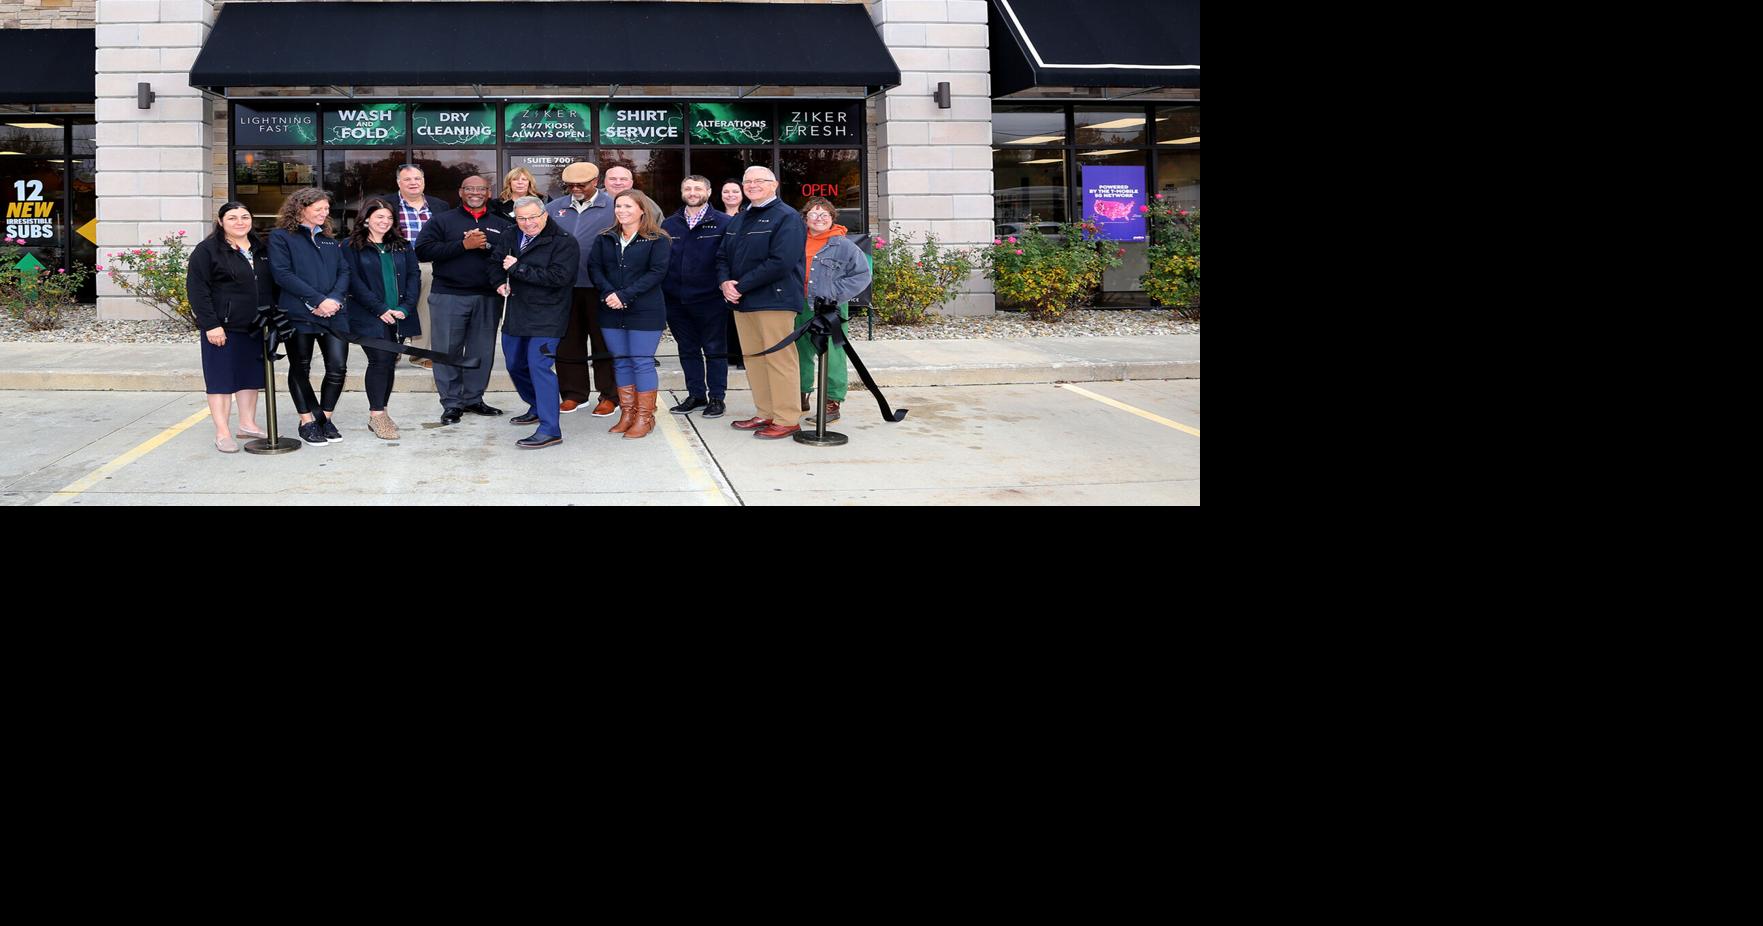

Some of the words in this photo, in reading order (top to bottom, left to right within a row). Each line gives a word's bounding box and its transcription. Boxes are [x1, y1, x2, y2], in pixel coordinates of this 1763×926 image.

[240, 116, 312, 125] LIGHTNING
[338, 110, 392, 121] WASH
[440, 112, 469, 122] DRY
[616, 110, 667, 121] SHIRT
[791, 111, 847, 123] ZIKER
[259, 124, 289, 132] FAST
[696, 120, 766, 128] ALTERATIONS
[341, 128, 388, 139] FOLD
[417, 126, 492, 136] CLEANING
[606, 126, 678, 138] SERVICE
[785, 125, 854, 137] FRESH.
[14, 180, 44, 201] 12
[802, 183, 838, 196] OPEN
[6, 202, 54, 217] NEW
[6, 224, 54, 239] SUBS
